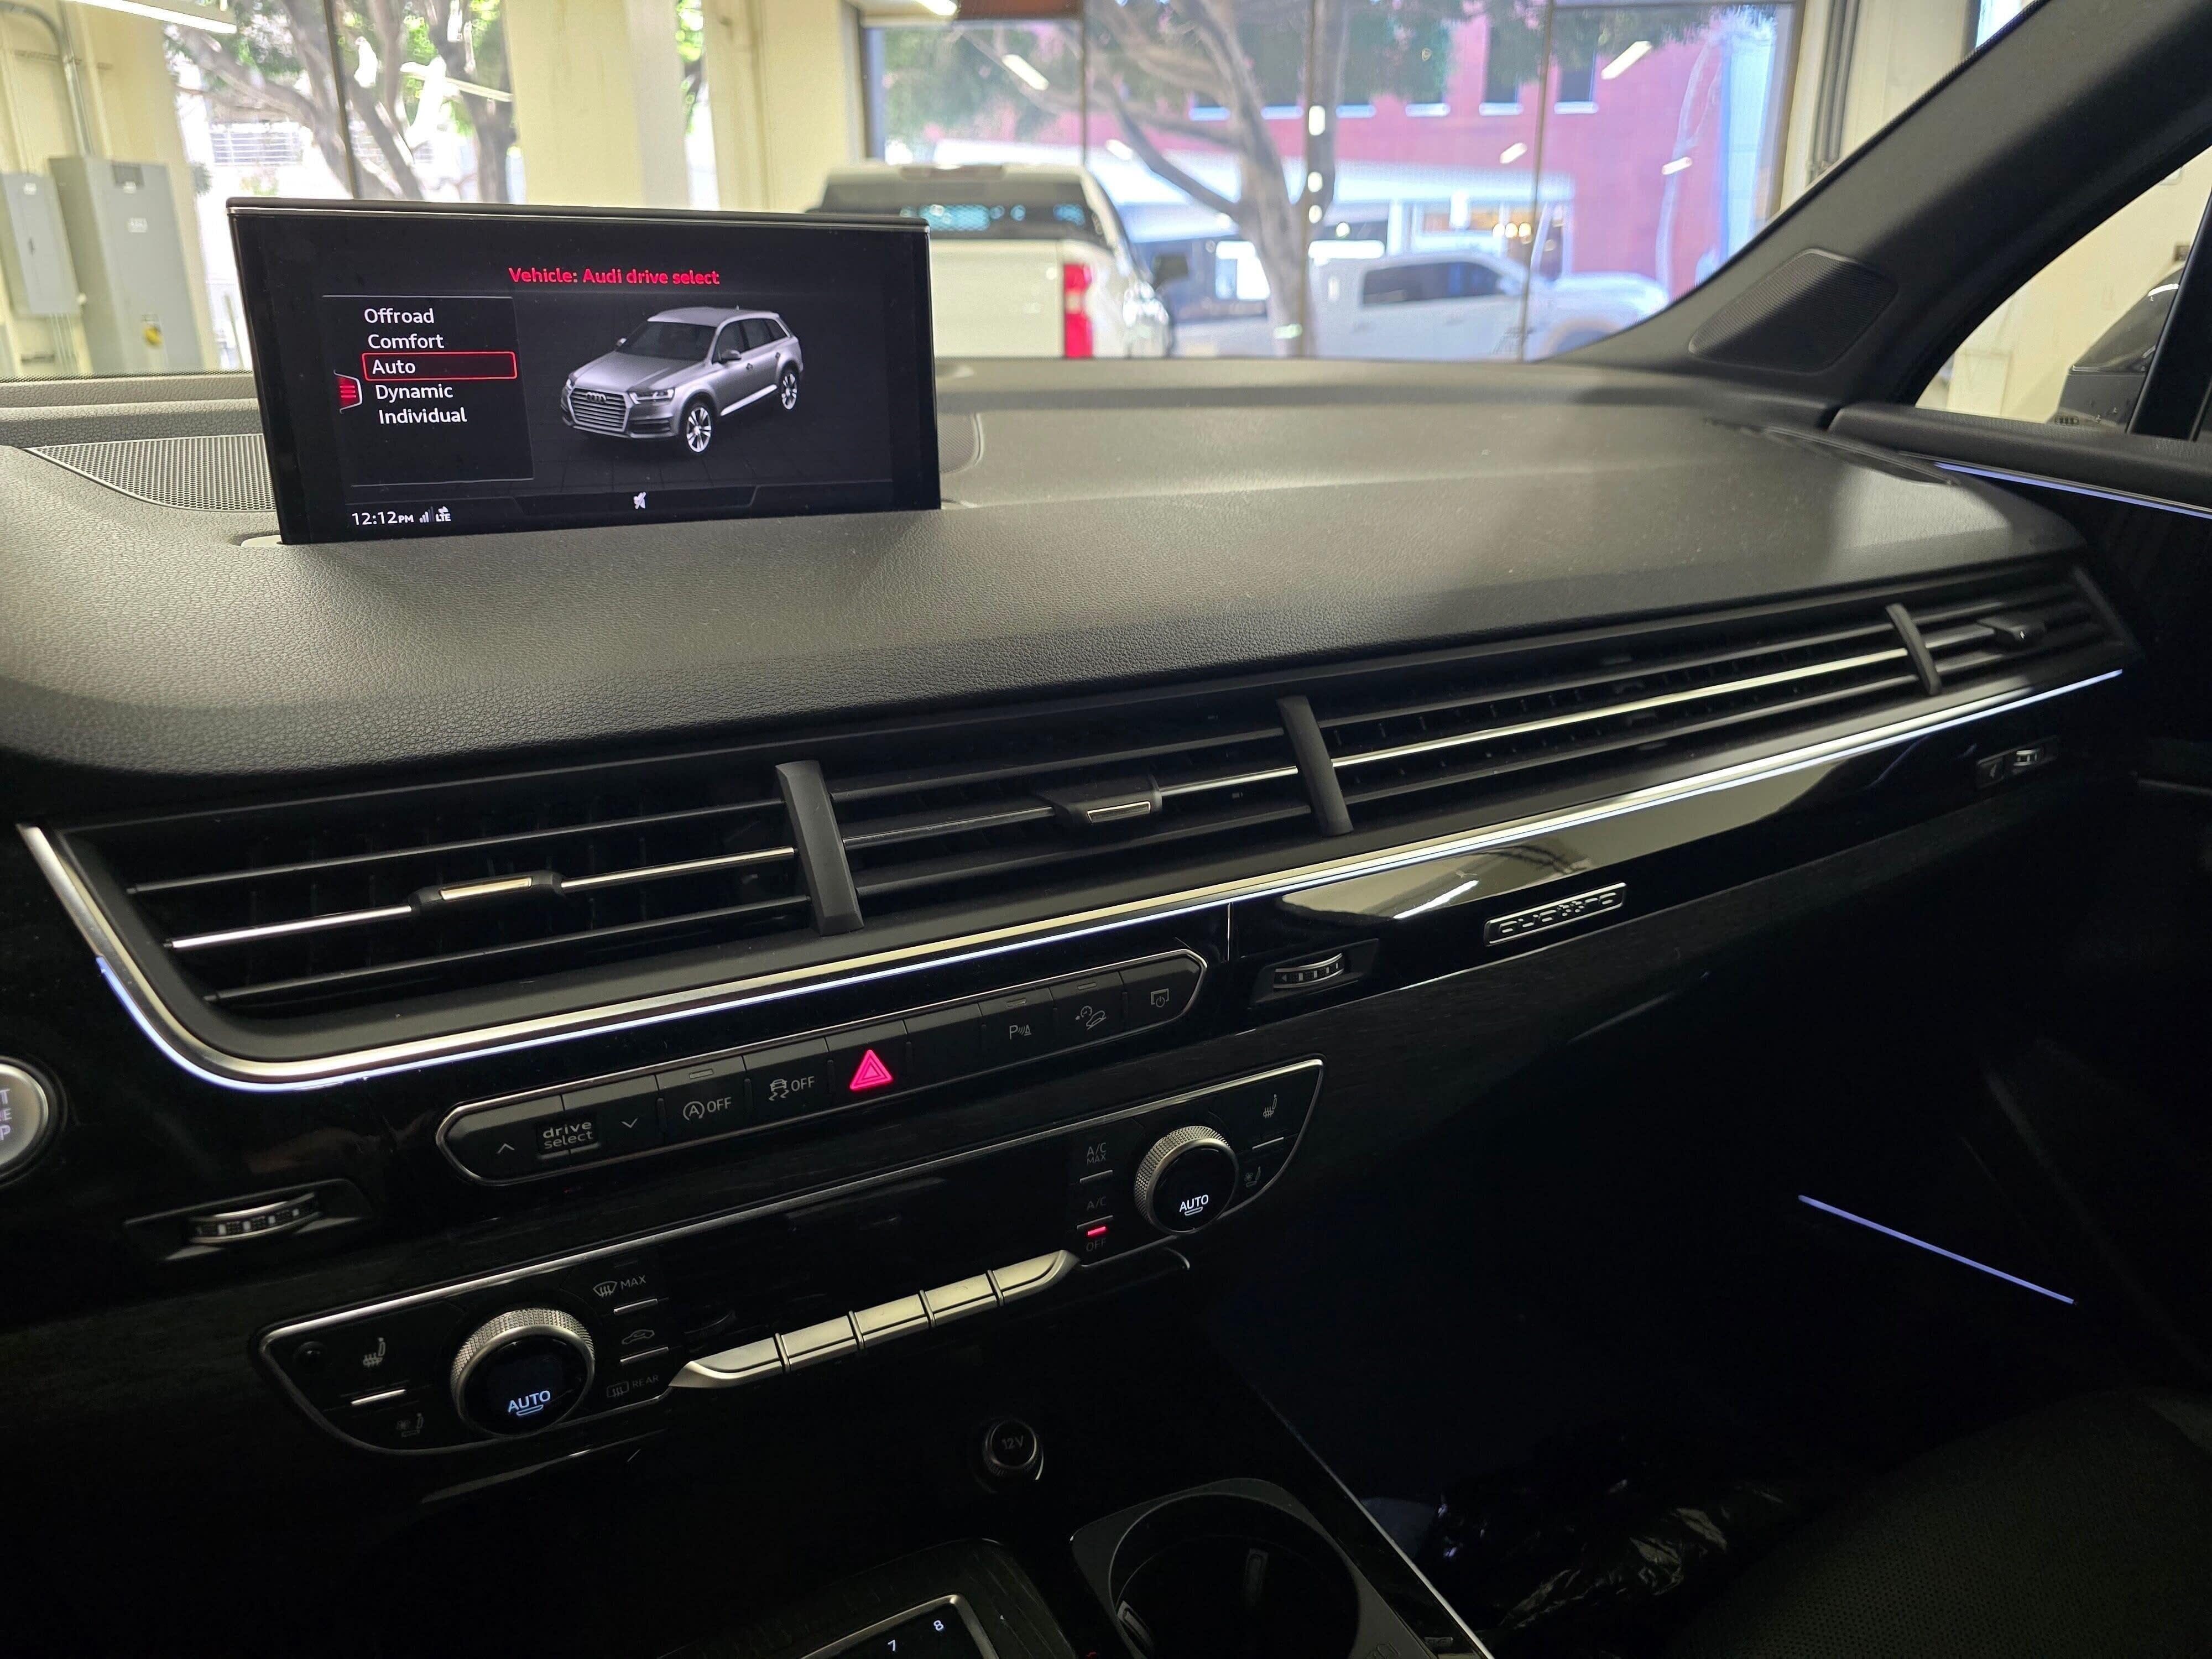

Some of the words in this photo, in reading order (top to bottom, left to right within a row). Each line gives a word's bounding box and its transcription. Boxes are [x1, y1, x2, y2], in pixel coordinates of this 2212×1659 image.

[508, 268, 578, 283] Vehicle:
[583, 268, 623, 284] Audi
[626, 269, 668, 284] drive
[672, 270, 720, 285] select
[364, 307, 435, 324] Offroad
[368, 333, 445, 349] Comfort
[372, 359, 416, 374] Auto
[375, 383, 453, 403] Dynamic
[379, 406, 467, 424] Individual
[435, 513, 451, 522] LTE
[791, 1076, 815, 1092] OFF
[707, 1097, 732, 1113] OFF
[543, 1121, 592, 1139] drive
[544, 1130, 593, 1150] select
[1087, 1142, 1107, 1158] A/C
[1087, 1153, 1107, 1165] MAX
[1086, 1195, 1107, 1211] A/C
[1179, 1194, 1209, 1213] AUTO
[1086, 1238, 1107, 1251] OFF
[620, 1275, 646, 1290] MAX
[632, 1375, 660, 1389] REAR
[507, 1390, 551, 1413] AUTO
[1001, 1434, 1024, 1449] 12V
[933, 1620, 945, 1632] 8
[888, 1639, 898, 1652] 7
